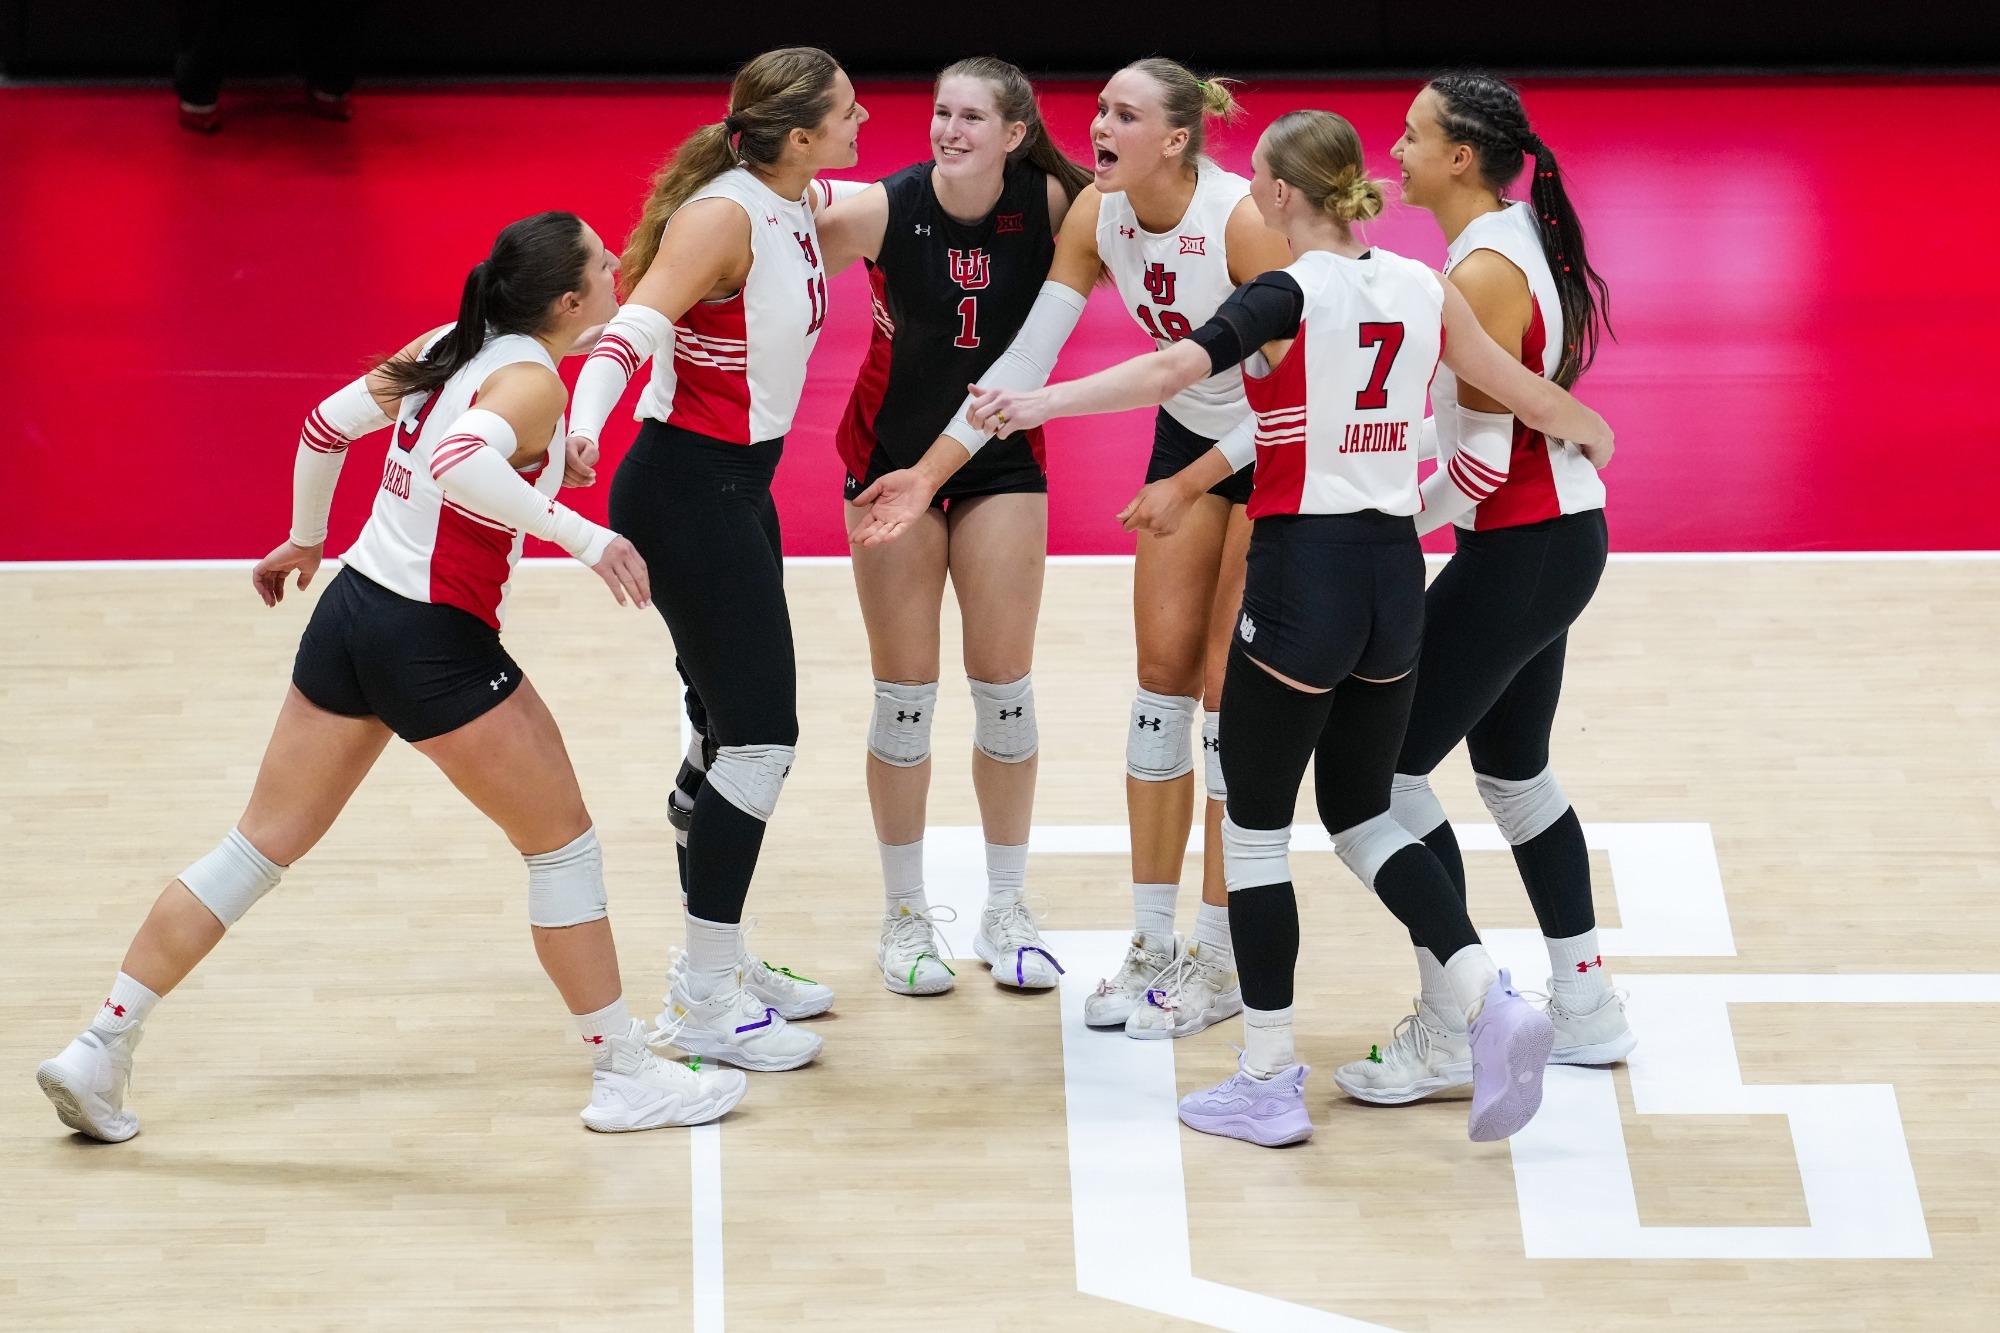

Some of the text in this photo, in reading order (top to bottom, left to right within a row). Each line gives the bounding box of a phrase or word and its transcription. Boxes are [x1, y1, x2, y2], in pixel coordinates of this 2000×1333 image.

[805, 271, 826, 337] 11
[954, 296, 980, 349] 1
[1355, 321, 1405, 410] 7
[1339, 421, 1408, 453] JARDINE
